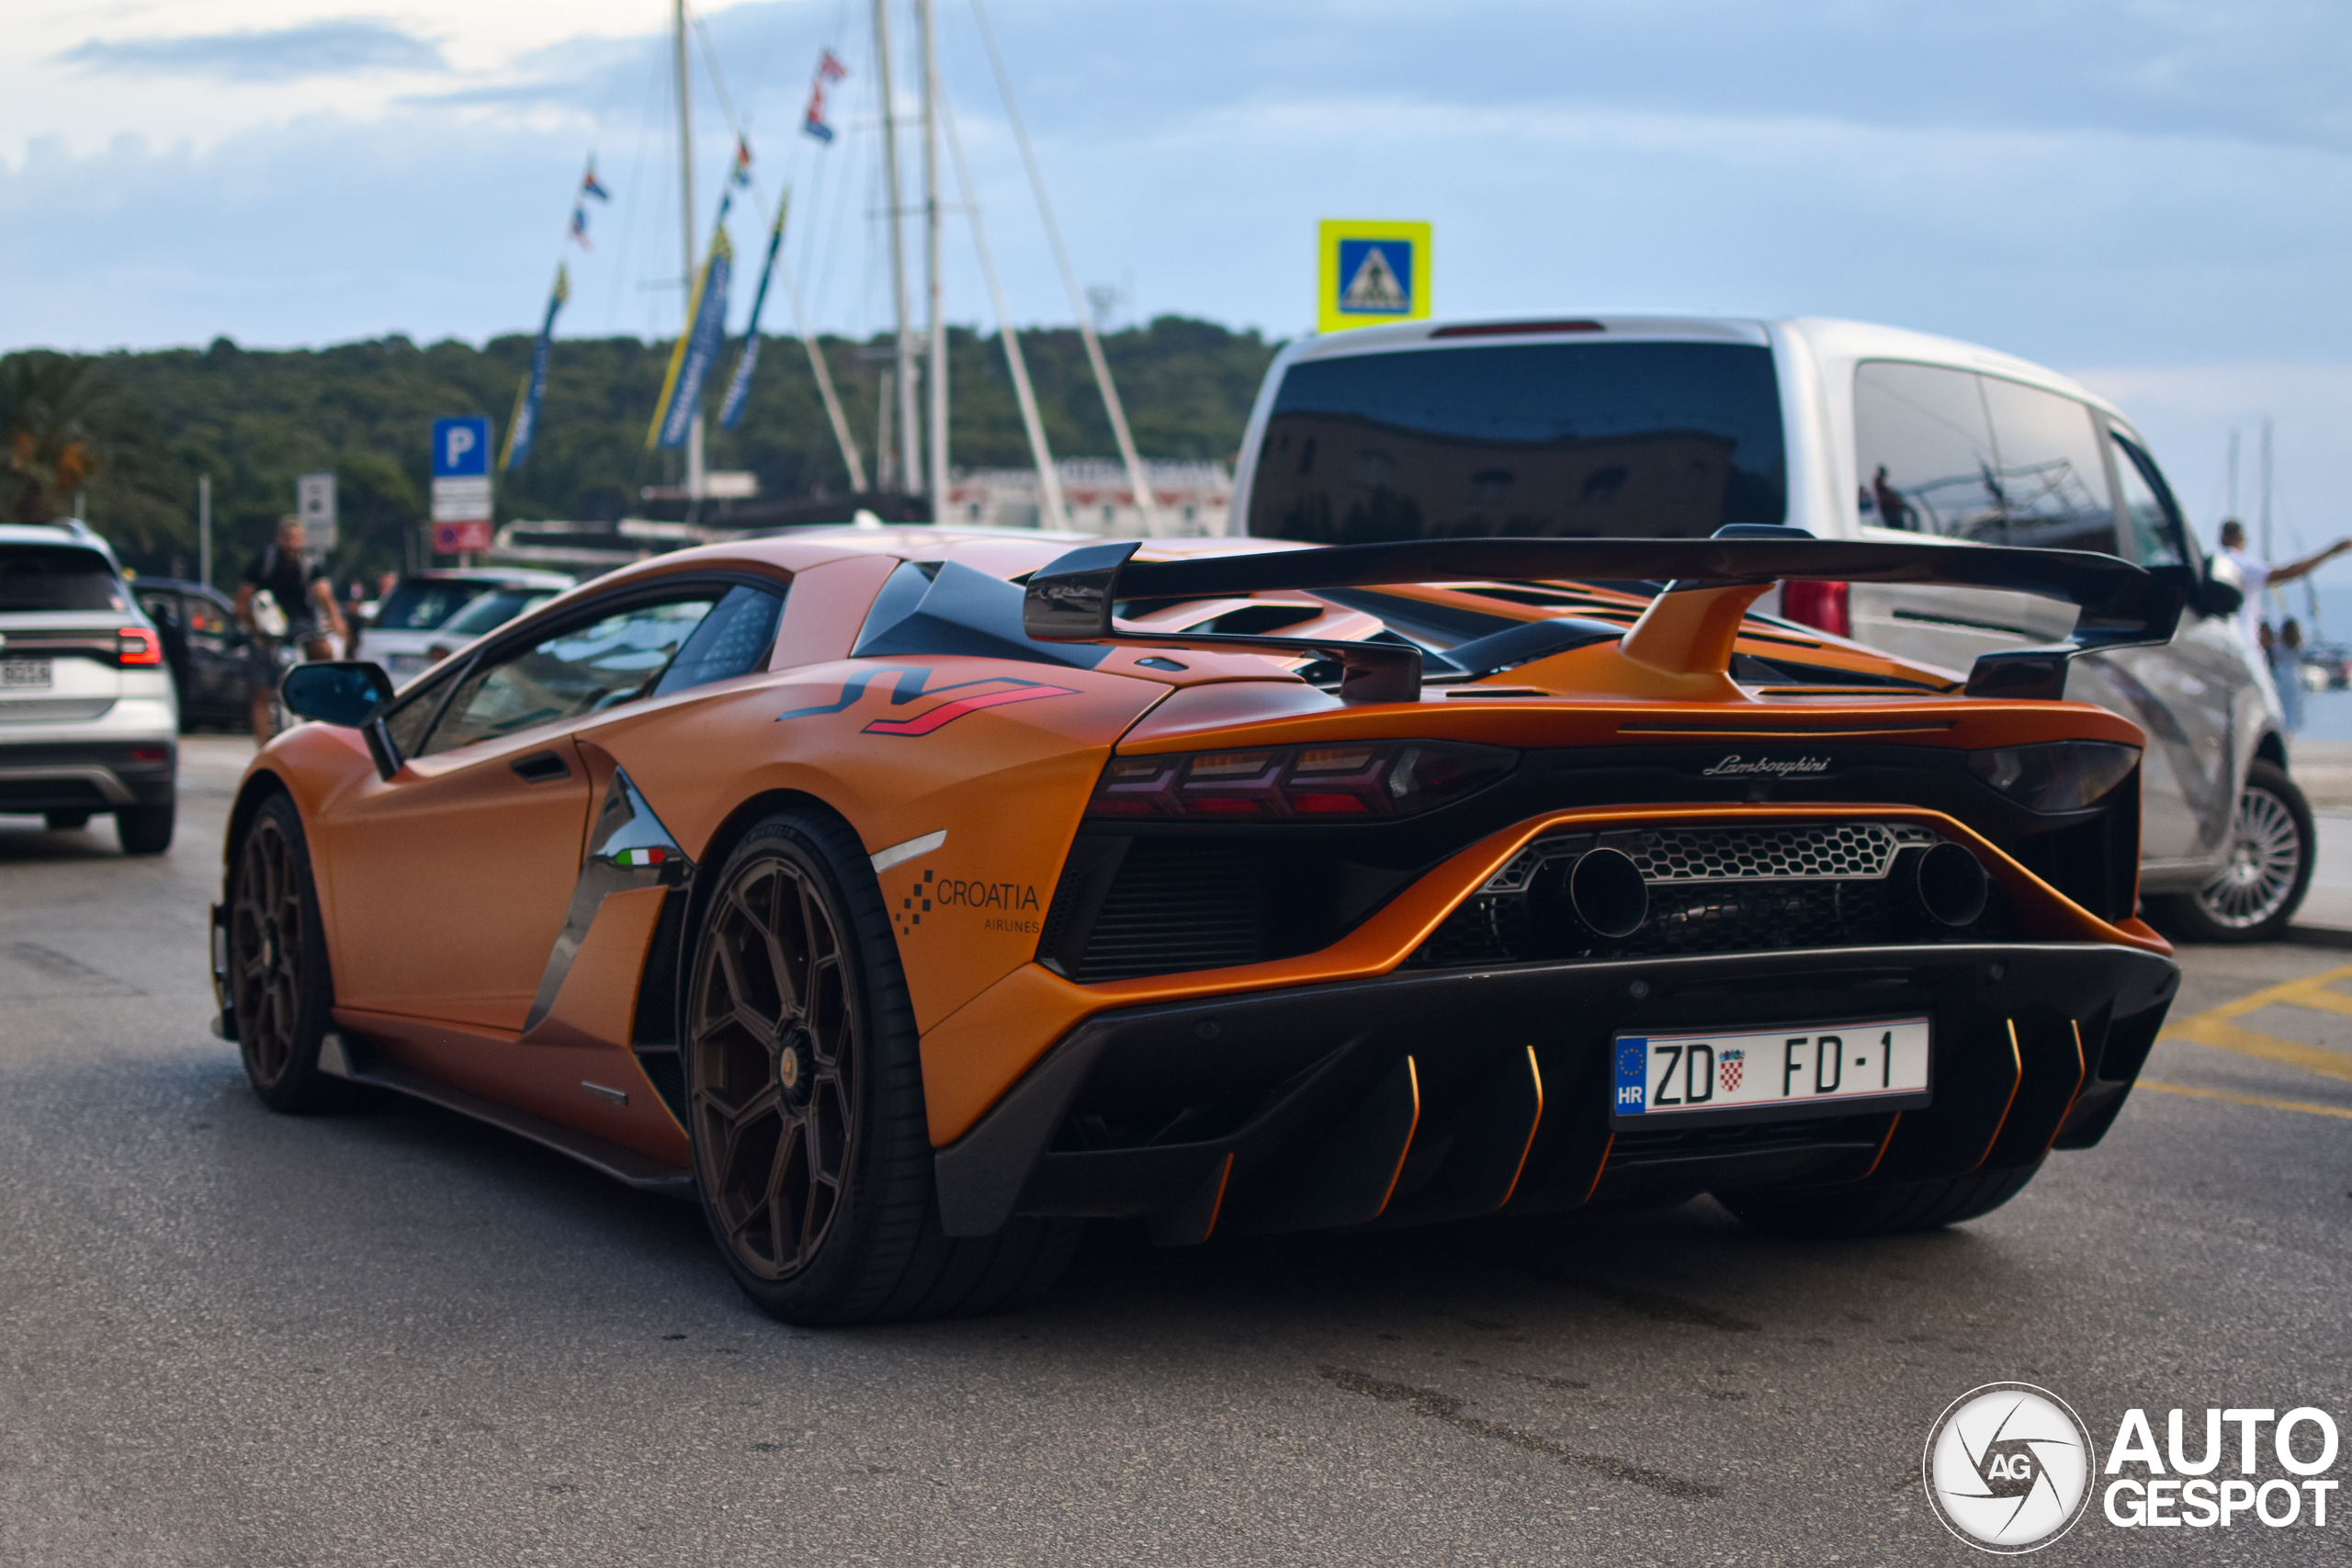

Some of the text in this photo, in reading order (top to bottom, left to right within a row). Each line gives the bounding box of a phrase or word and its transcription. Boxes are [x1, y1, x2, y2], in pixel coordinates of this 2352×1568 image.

[447, 426, 475, 468] P
[1702, 754, 1831, 776] Lamborghini
[937, 879, 1039, 911] CROATIA
[984, 919, 1040, 934] AIRLINES
[1653, 1031, 1892, 1106] ZD FD-1
[1618, 1086, 1643, 1104] HR
